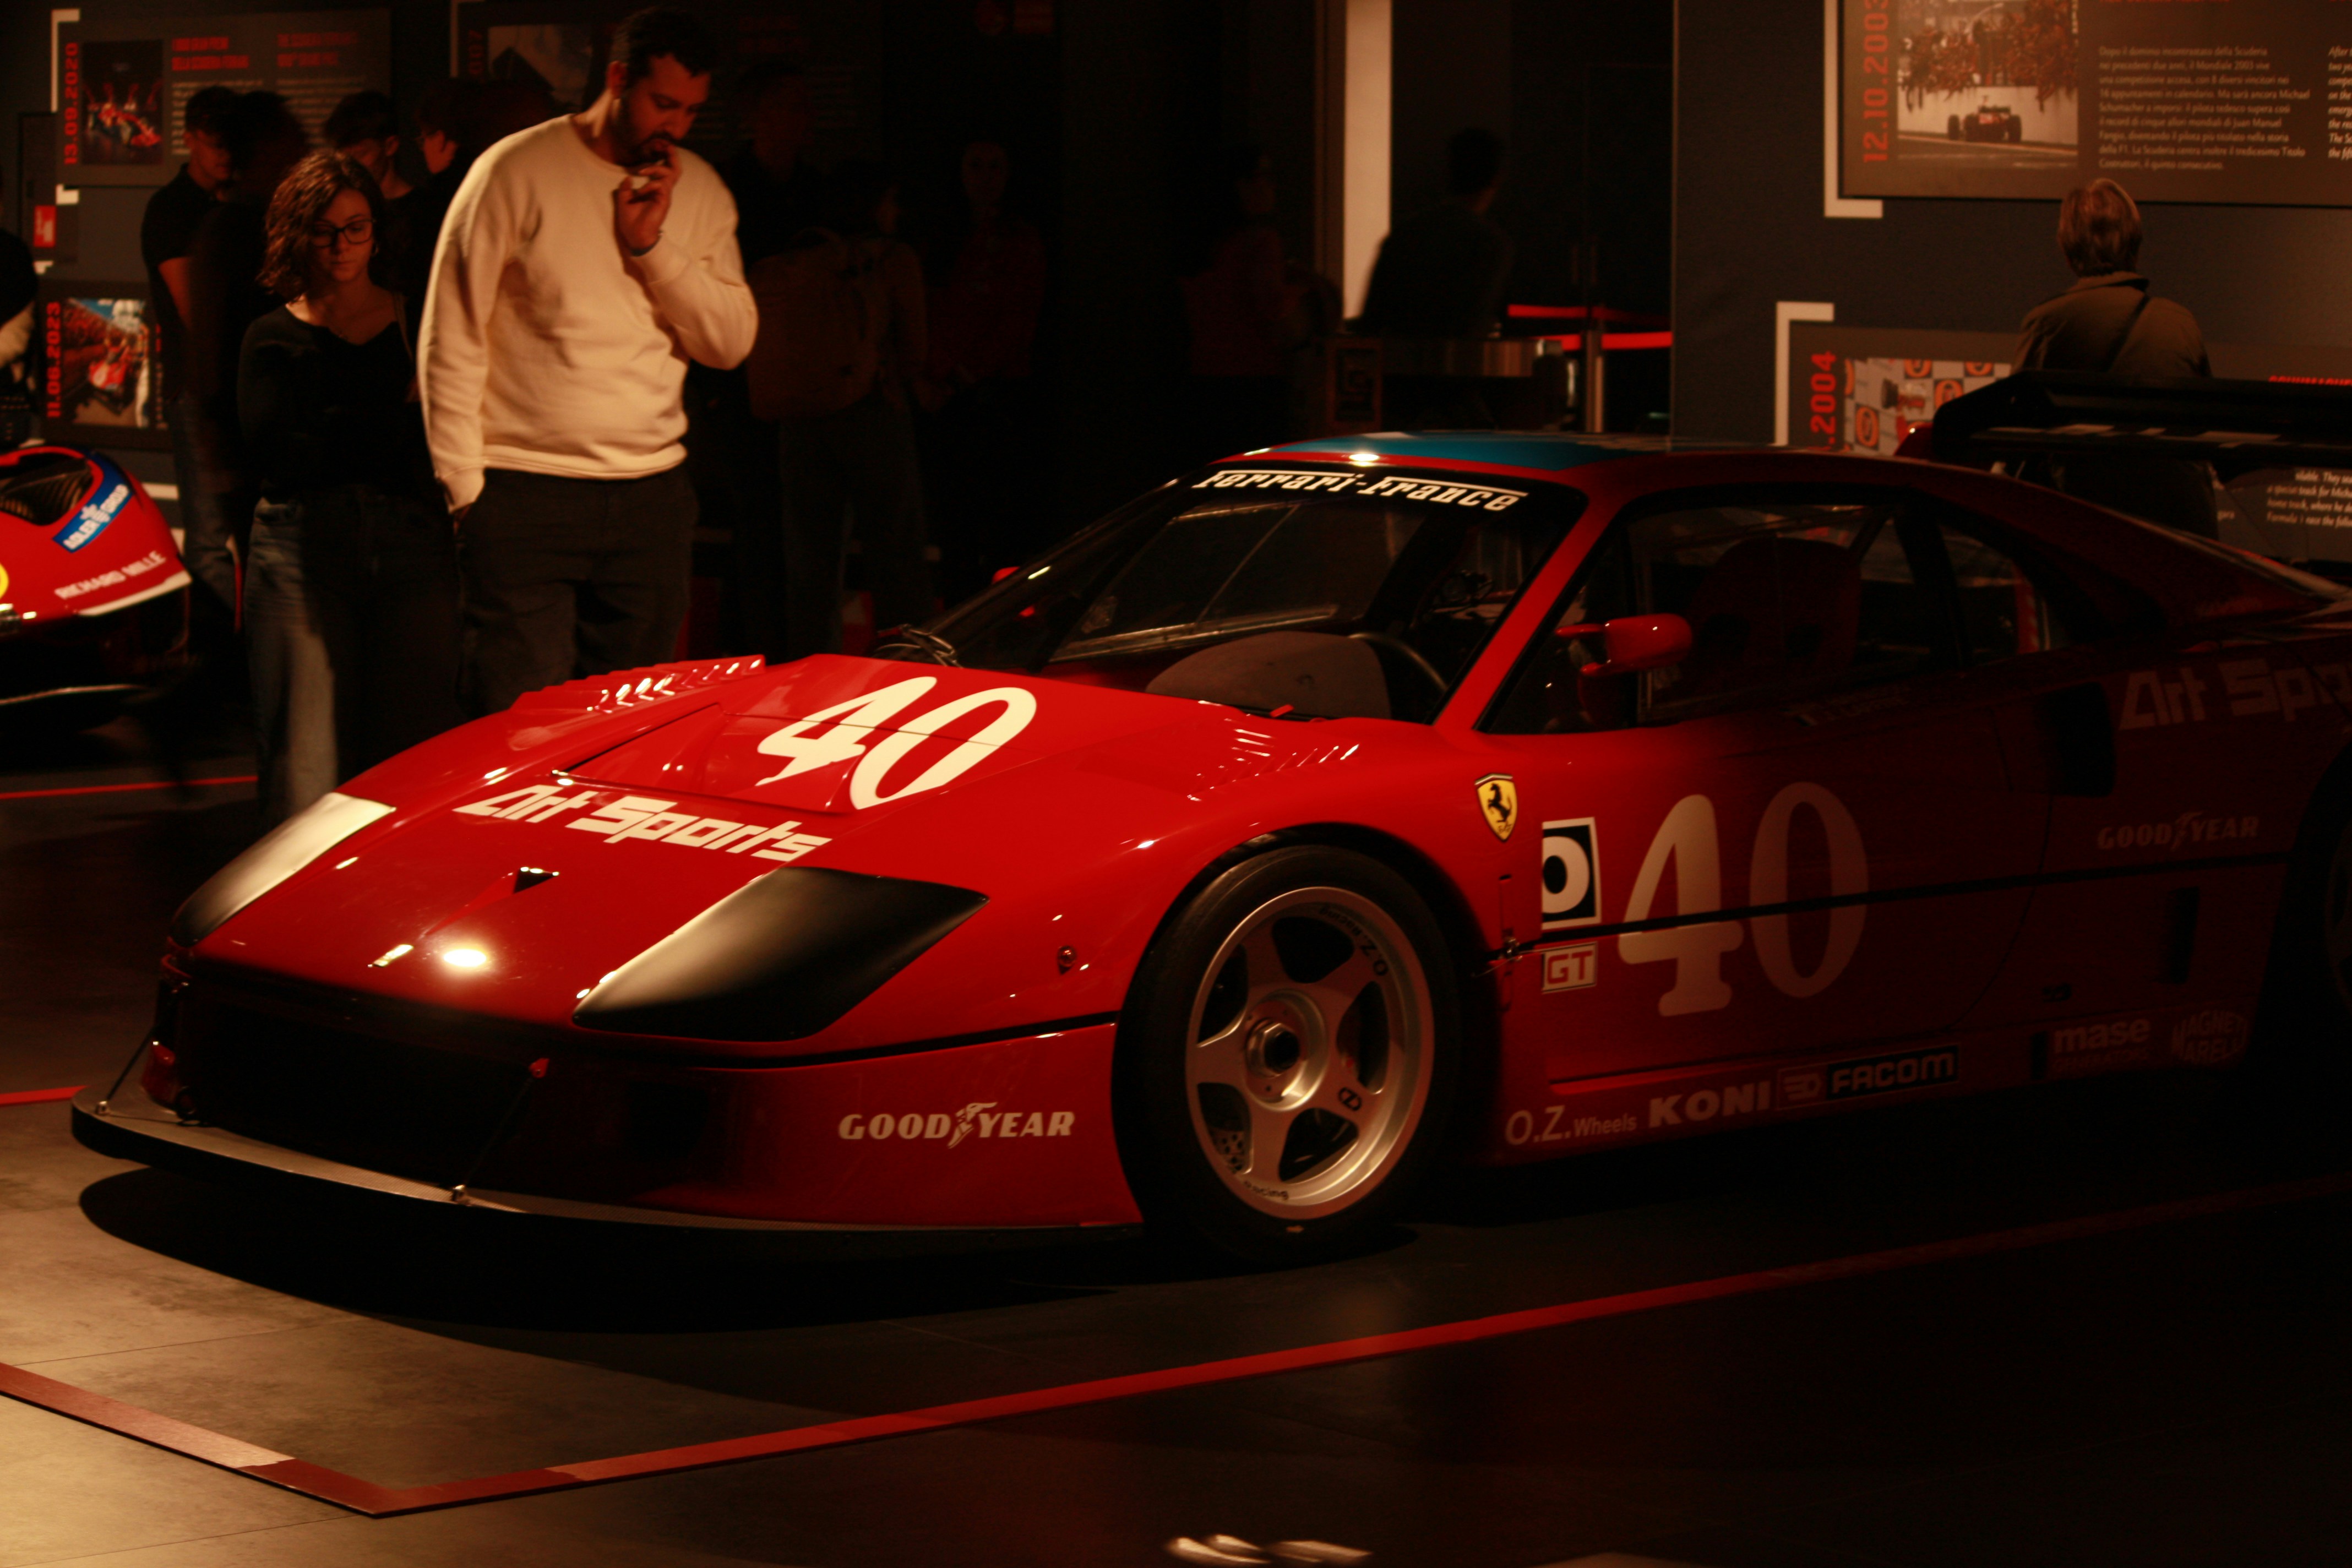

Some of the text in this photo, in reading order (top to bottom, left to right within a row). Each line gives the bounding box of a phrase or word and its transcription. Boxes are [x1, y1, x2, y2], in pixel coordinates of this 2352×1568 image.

[2099, 46, 2121, 58] Dopo
[2214, 46, 2233, 56] della
[2234, 46, 2268, 56] Scuderia
[2152, 61, 2167, 69] due
[2196, 61, 2232, 70] Mondiale
[2234, 61, 2254, 70] 2003
[2115, 76, 2165, 85] competizione
[2218, 74, 2243, 85] diversi
[2217, 89, 2230, 98] Ma
[2279, 89, 2311, 99] Michael
[2099, 102, 2144, 112] Schumacher
[2192, 103, 2214, 115] pilota
[2215, 104, 2246, 113] tedesco
[2247, 105, 2273, 116] supera
[2105, 116, 2130, 126] record
[2141, 117, 2166, 128] cinque
[2233, 117, 2251, 129] Juan
[2252, 117, 2282, 128] Manuel
[2099, 144, 2117, 154] della
[2132, 144, 2141, 154] La
[2143, 145, 2175, 155] Scuderia
[2235, 146, 2280, 156] tredicesimo
[2282, 146, 2306, 156] Titolo
[2128, 130, 2170, 140] diventando
[2178, 130, 2201, 143] pilota
[2247, 132, 2266, 142] nella
[2267, 134, 2289, 143] storia
[1192, 470, 1529, 512] Ferrari-France
[54, 549, 167, 600] RICHARD MILLE
[2119, 658, 2352, 731] Art Spo
[755, 676, 1037, 810] 40
[451, 784, 832, 862] Art Sports
[1617, 781, 1870, 1017] 40
[1547, 950, 1593, 984] GT
[2054, 1017, 2151, 1054] mase
[1829, 1050, 1957, 1096] FACOM
[1648, 1079, 1770, 1129] KONI
[837, 1104, 1076, 1146] GOODYEAR
